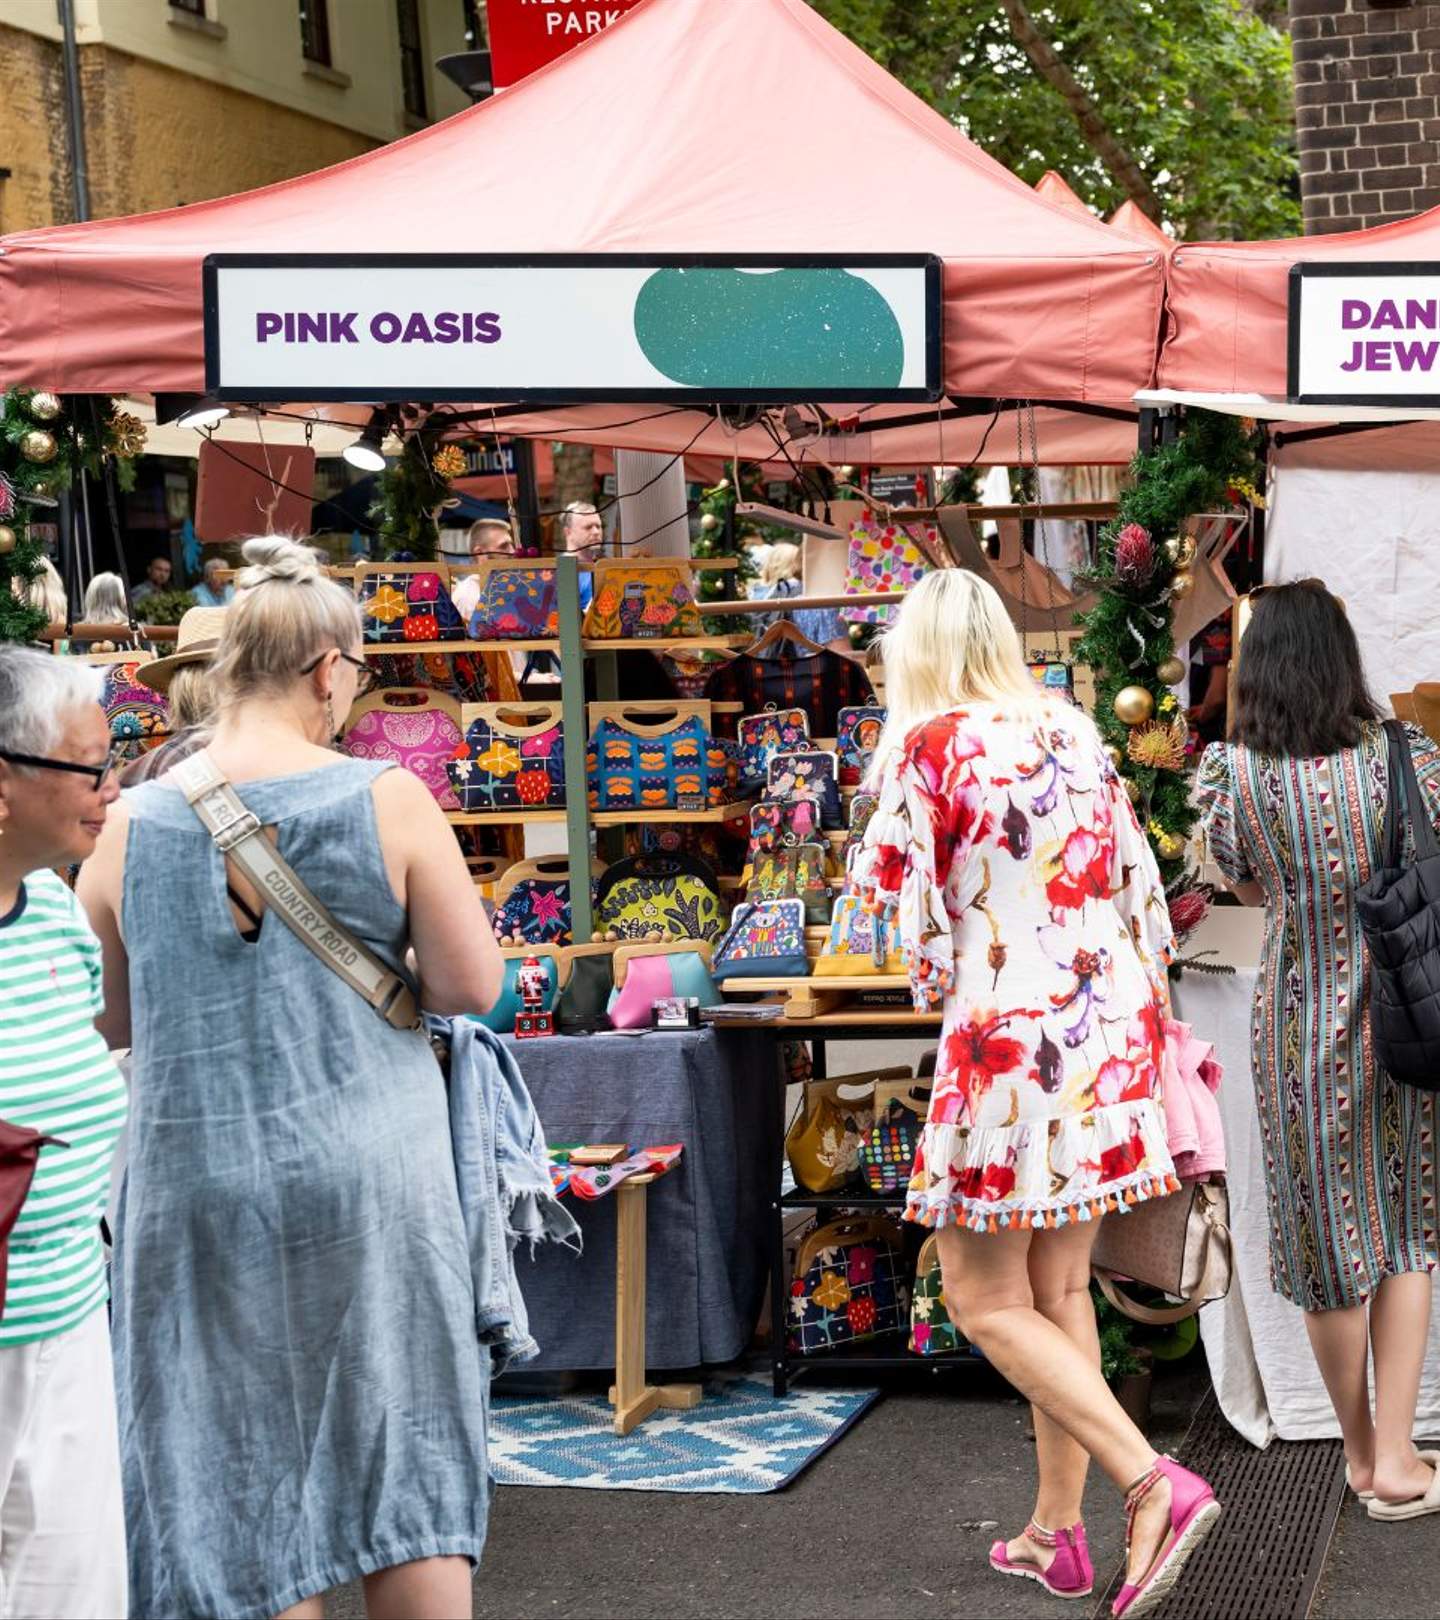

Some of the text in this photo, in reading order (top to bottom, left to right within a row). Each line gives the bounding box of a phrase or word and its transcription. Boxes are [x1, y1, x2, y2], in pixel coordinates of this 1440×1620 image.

[256, 312, 502, 344] PINK OASIS
[264, 869, 359, 968] COUNTRY ROAD
